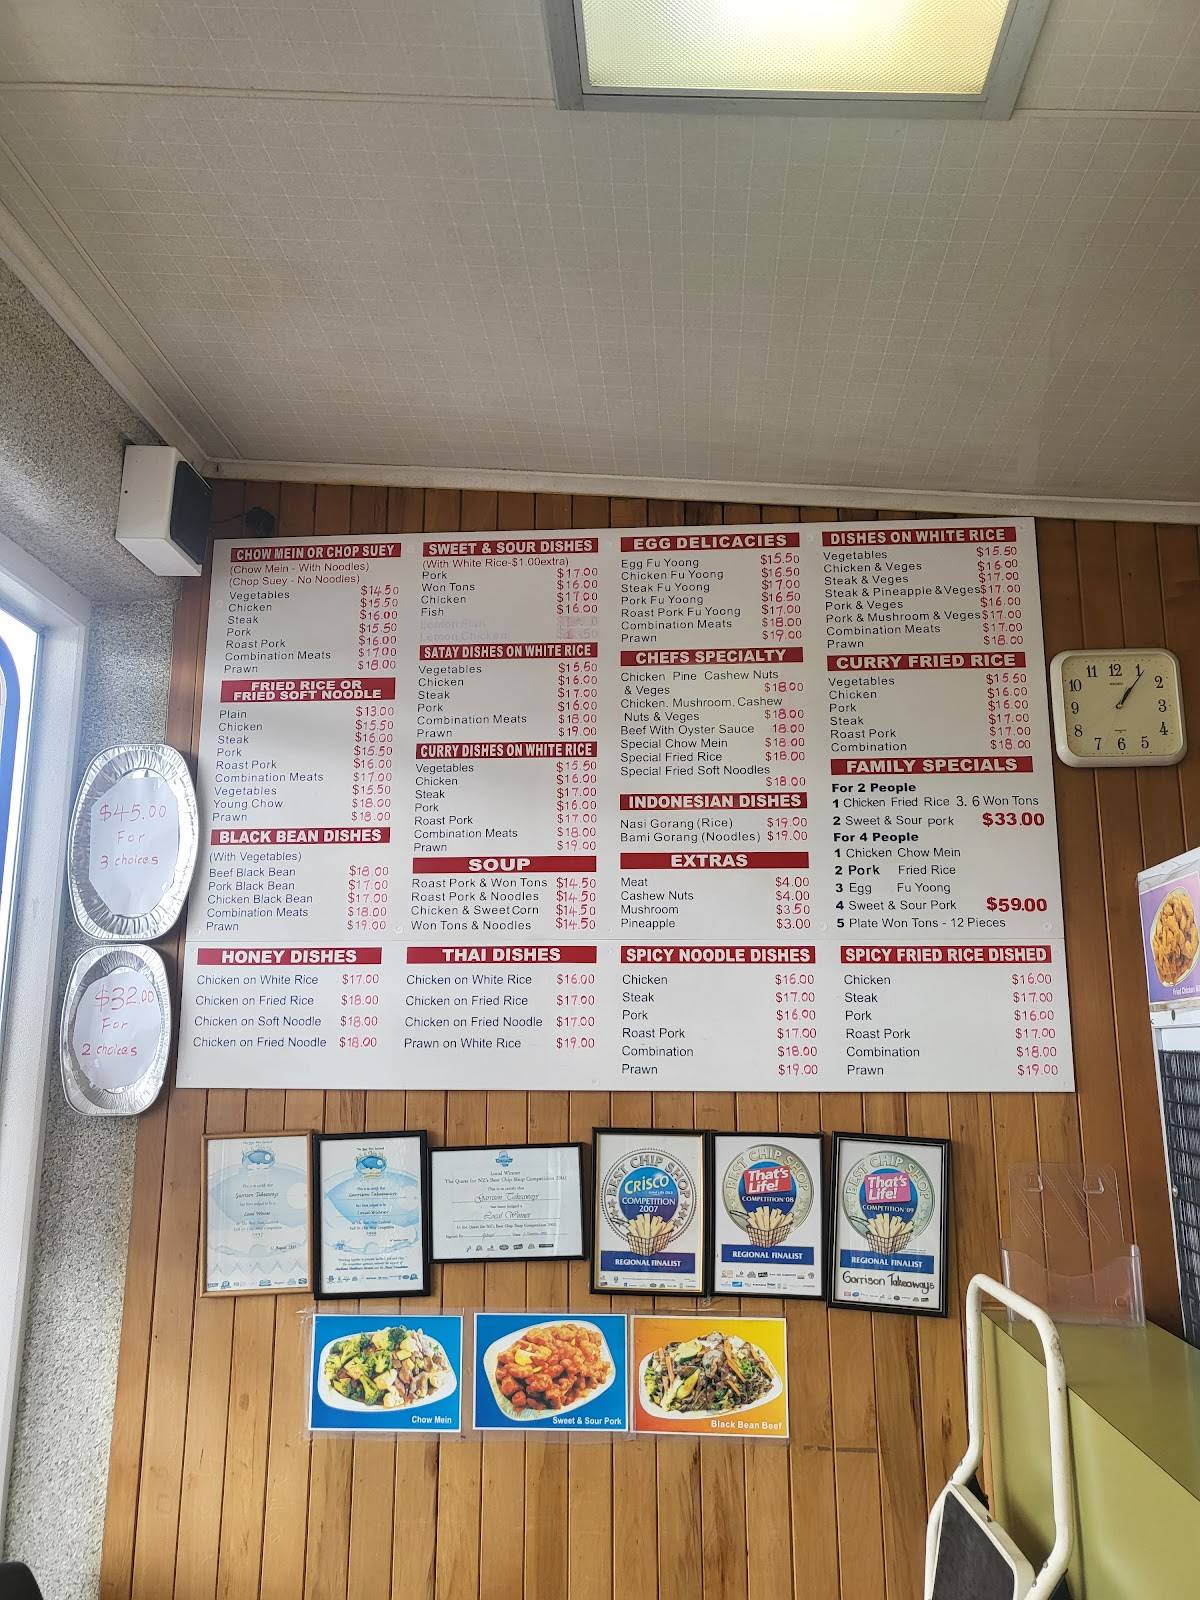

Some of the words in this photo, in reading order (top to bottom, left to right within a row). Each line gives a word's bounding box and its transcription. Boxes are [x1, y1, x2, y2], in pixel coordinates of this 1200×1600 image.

[634, 538, 670, 550] EGG
[678, 535, 786, 548] DELICACIES
[831, 532, 886, 544] DISHES
[890, 531, 911, 542] ON
[916, 530, 964, 542] WHITE
[969, 529, 1004, 540] RICE
[237, 548, 271, 560] CHOW
[274, 548, 304, 559] MEIN
[307, 547, 323, 558] OR
[327, 546, 359, 557] CHOP
[362, 545, 394, 556] SUEY
[429, 543, 477, 555] SWEET
[482, 543, 491, 553] &
[497, 542, 536, 553] SOUR
[541, 540, 592, 552] DISHES
[622, 560, 642, 570] Egg
[647, 559, 660, 567] Fu
[664, 558, 698, 568] Yoong
[761, 552, 799, 565] $15.50
[230, 590, 290, 601] Vegetables
[361, 585, 398, 596] $14.50
[424, 647, 456, 658] SATAY
[462, 646, 503, 657] DISHES
[506, 646, 522, 657] ON
[525, 645, 561, 656] WHITE
[565, 644, 590, 656] RICE
[636, 652, 689, 664] CHEFS
[695, 649, 786, 663] SPECIALTY
[837, 656, 900, 669] CURRY
[909, 655, 964, 667] FRIED
[971, 654, 1015, 666] RICE
[1086, 665, 1098, 677] 11
[1109, 664, 1122, 676] 12
[1136, 664, 1141, 676] 1
[252, 682, 295, 691] FRIED
[300, 681, 335, 690] RICE
[340, 680, 361, 689] OR
[1069, 679, 1082, 692] 10
[1155, 676, 1163, 688] 2
[234, 692, 275, 700] FRIED
[280, 691, 317, 700] SOFT
[322, 690, 381, 699] NOODLE
[1071, 702, 1079, 714] 9
[1158, 699, 1167, 712] 3
[1074, 724, 1083, 737] 8
[1160, 722, 1168, 735] 4
[1094, 738, 1101, 750] 7
[1118, 737, 1126, 750] 6
[1141, 736, 1149, 748] 5
[421, 745, 458, 757] CURRY
[462, 744, 503, 756] DISHES
[507, 744, 522, 756] ON
[526, 744, 562, 756] WHITE
[566, 743, 592, 756] RICE
[847, 760, 916, 773] FAMILY
[923, 758, 1017, 772] SPECIALS
[832, 784, 853, 792] For
[858, 783, 866, 792] 2
[871, 783, 916, 794] People
[214, 800, 247, 810] Young
[252, 799, 283, 808] Chow
[630, 795, 733, 808] INDONESIAN
[740, 794, 801, 807] DISHES
[100, 804, 166, 822] $45.00
[621, 819, 646, 828] Nasi
[650, 819, 693, 830] Gorang
[697, 818, 732, 830] (Rice)
[982, 812, 1044, 827] $33.00
[117, 832, 145, 843] For
[220, 831, 271, 843] BLACK
[276, 830, 318, 842] BEAN
[324, 829, 381, 842] DISHES
[834, 833, 855, 842] For
[860, 832, 867, 842] 4
[873, 832, 918, 844] People
[100, 856, 108, 868] 3
[112, 854, 159, 866] choices
[209, 852, 235, 864] (With
[240, 852, 301, 863] Vegetables)
[672, 854, 747, 867] EXTRAS
[469, 858, 530, 871] SOUP
[621, 877, 648, 886] Meat
[776, 877, 809, 887] $4.00
[621, 891, 664, 900] Cashew
[669, 891, 694, 900] Nuts
[776, 890, 809, 901] $4.00
[987, 897, 1047, 912] $59.00
[222, 950, 285, 963] HONEY
[291, 950, 356, 963] DISHES
[442, 949, 486, 961] THAI
[493, 948, 560, 961] DISHES
[627, 949, 674, 962] SPICY
[680, 949, 745, 962] NOODLE
[751, 949, 810, 962] DISHES
[846, 948, 892, 961] SPICY
[897, 949, 942, 961] FRIED
[948, 948, 984, 961] RICE
[989, 948, 1046, 961] DISHED
[342, 974, 379, 984] $17.00
[95, 986, 155, 1012] $32.00
[102, 1019, 128, 1032] For
[195, 1016, 237, 1026] Chicken
[258, 1016, 279, 1026] Soft
[283, 1016, 321, 1026] Noodle
[340, 1016, 378, 1028] $18.00
[82, 1043, 91, 1056] 2
[96, 1042, 138, 1056] choices
[404, 1038, 439, 1048] Prawn
[461, 1038, 492, 1048] White
[497, 1038, 521, 1048] Rice
[556, 1037, 594, 1049] $19.00
[622, 1064, 657, 1074] Prawn
[779, 1064, 818, 1076] $19.00
[607, 1164, 628, 1196] BEST
[630, 1155, 663, 1168] CHIP
[665, 1163, 690, 1198] SHOP
[726, 1157, 746, 1190] BEST
[749, 1150, 782, 1160] CHIP
[785, 1156, 808, 1192] SHOP
[748, 1168, 788, 1182] That's
[846, 1163, 868, 1196] BEST
[870, 1156, 903, 1167] CHIP
[906, 1164, 930, 1199] SHOP
[868, 1176, 907, 1189] That's
[749, 1181, 778, 1193] Life!
[869, 1188, 897, 1200] Life!
[622, 1197, 675, 1205] COMPETITION
[852, 1257, 888, 1265] REGIONAL
[891, 1259, 923, 1268] FINALIST
[843, 1271, 885, 1286] Garrison
[888, 1272, 934, 1294] Takeaways
[411, 1416, 432, 1424] Chow
[435, 1416, 452, 1424] Mein
[552, 1416, 575, 1425] Sweet
[578, 1416, 583, 1424] &
[585, 1417, 602, 1425] Sour
[604, 1417, 622, 1425] Pork
[711, 1420, 735, 1429] Black
[737, 1421, 759, 1429] Bean
[762, 1421, 782, 1430] Beef
